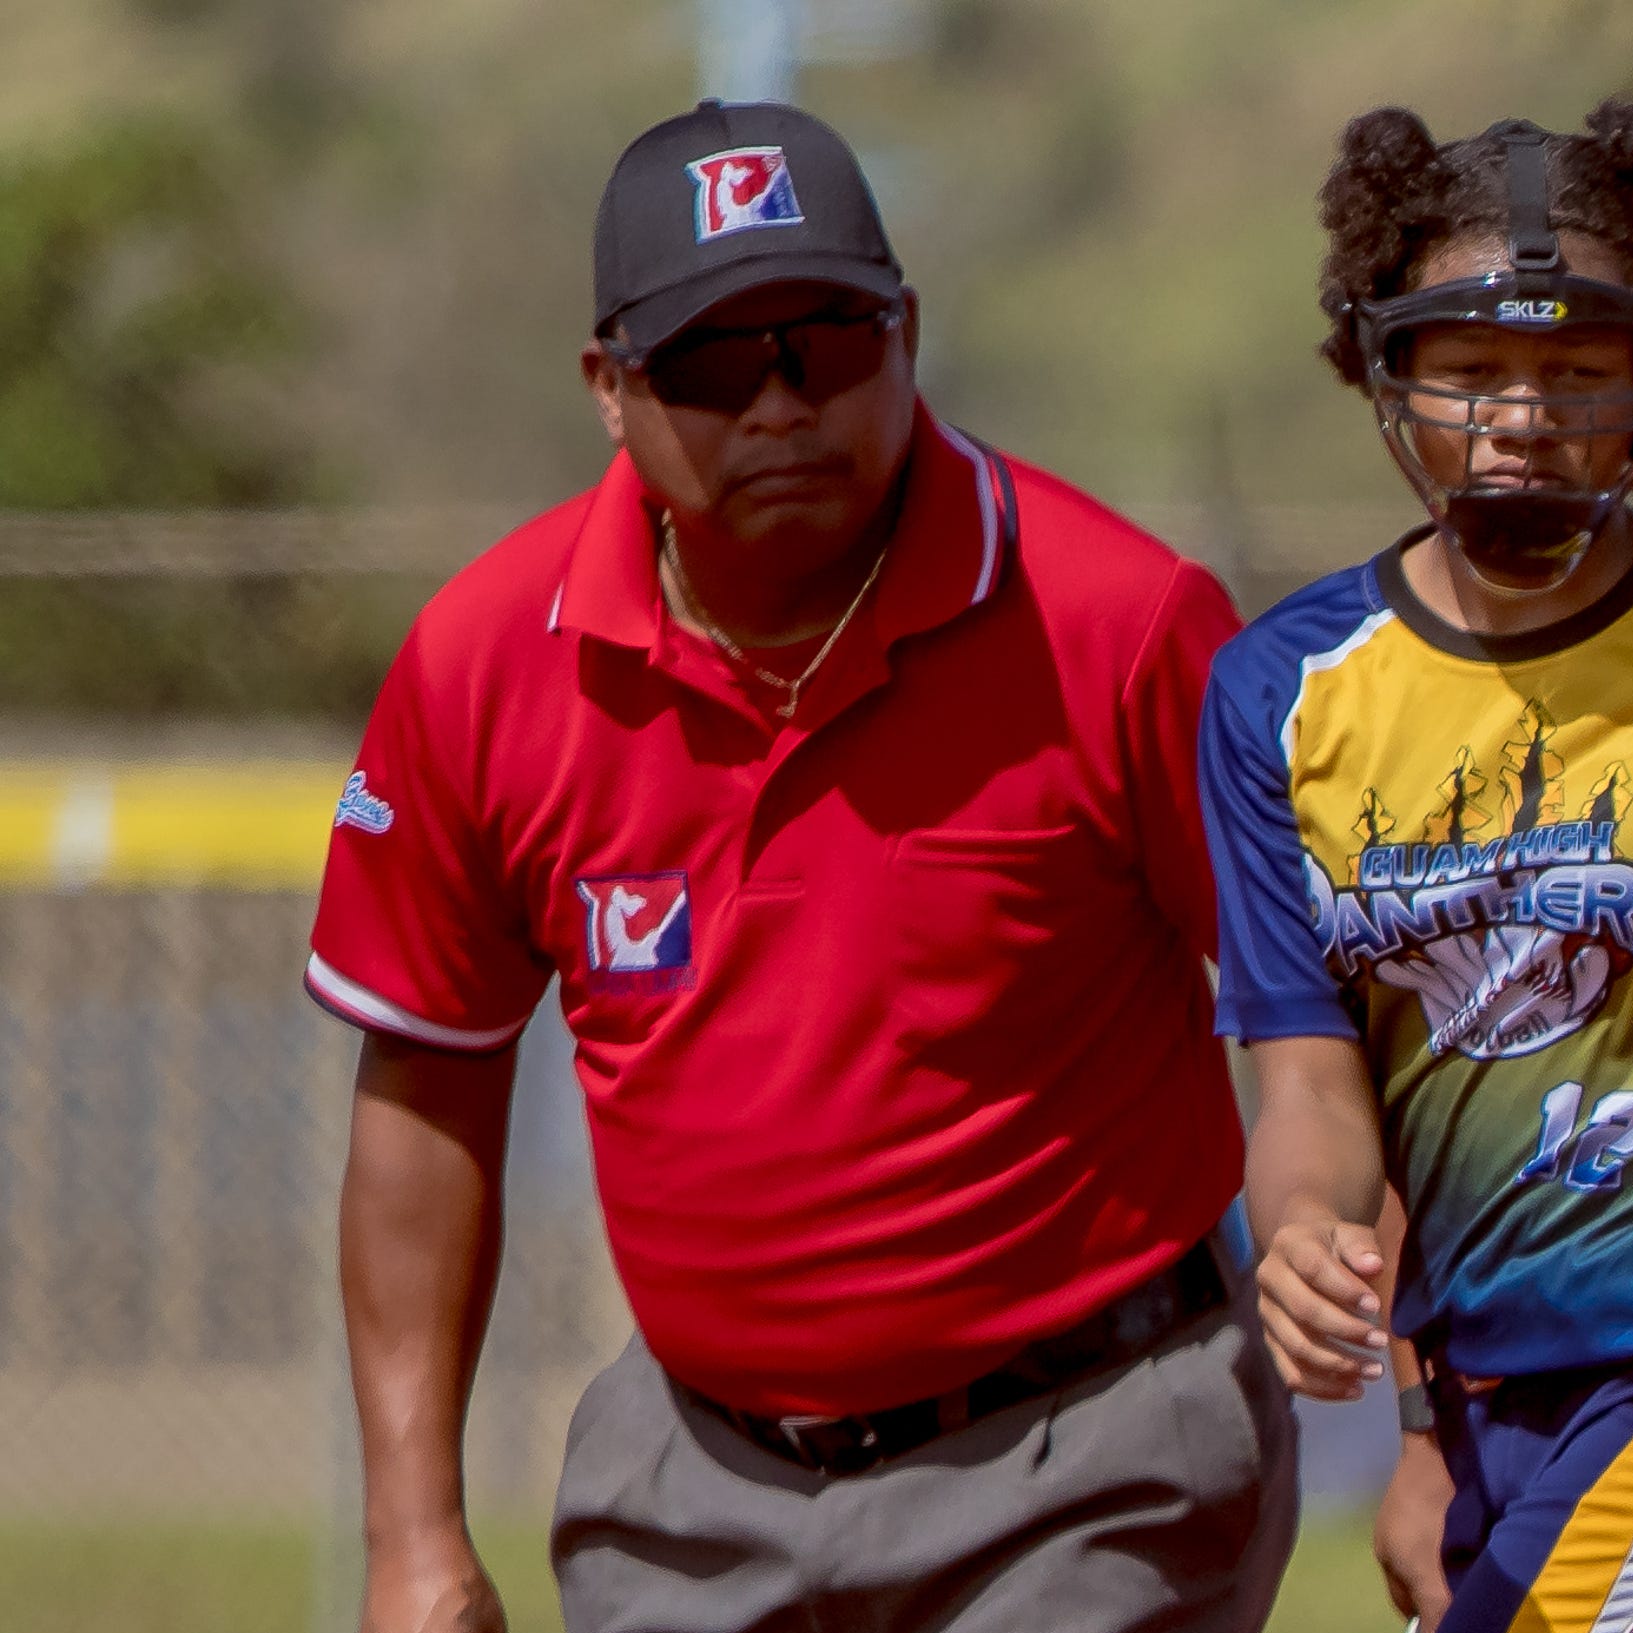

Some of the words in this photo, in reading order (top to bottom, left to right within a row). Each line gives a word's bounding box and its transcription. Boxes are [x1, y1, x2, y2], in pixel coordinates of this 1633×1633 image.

[1500, 301, 1556, 318] SKLZ
[1359, 837, 1506, 889] GUAM
[1501, 820, 1615, 871] HIGH
